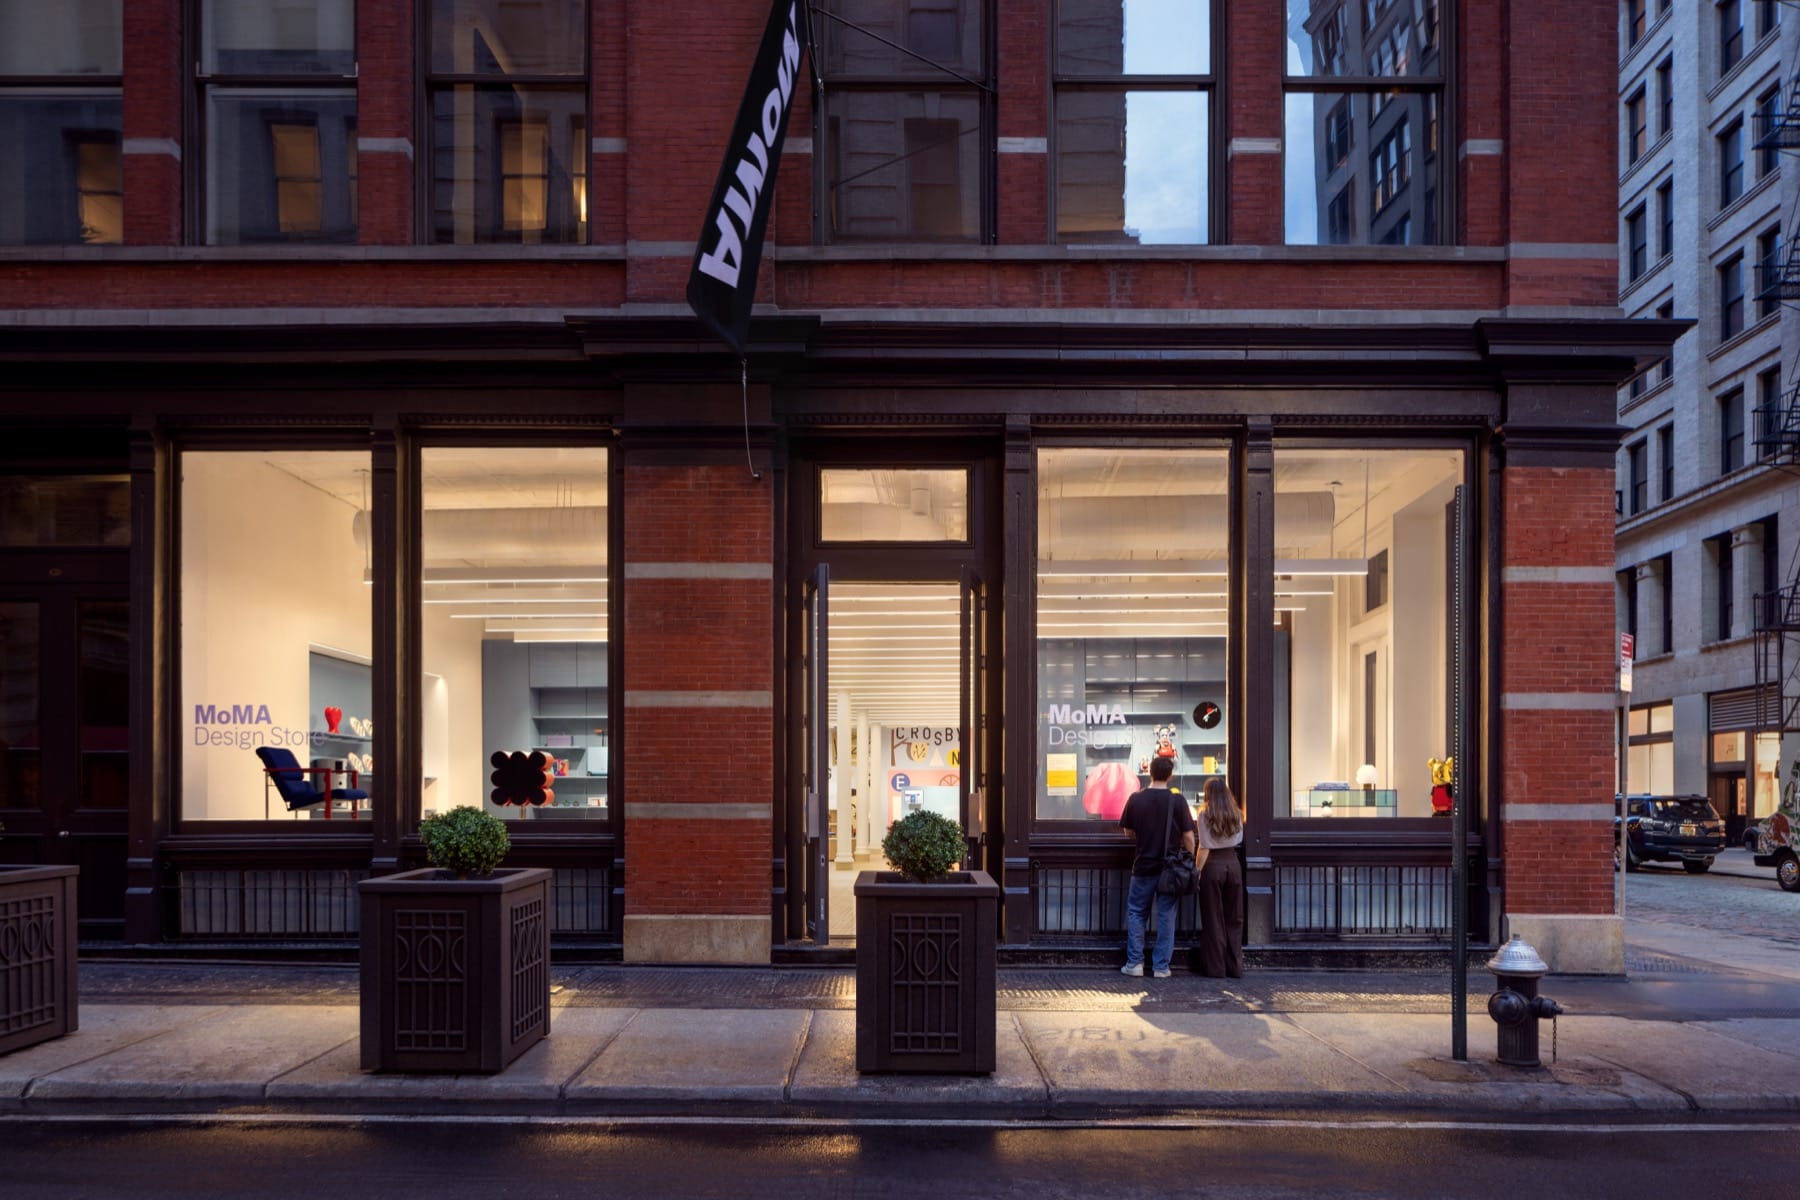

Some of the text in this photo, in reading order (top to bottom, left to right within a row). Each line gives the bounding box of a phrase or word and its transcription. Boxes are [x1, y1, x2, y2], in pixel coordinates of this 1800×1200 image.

[194, 704, 272, 725] MoMA
[1049, 704, 1127, 724] MoMA
[194, 726, 325, 750] Design Store
